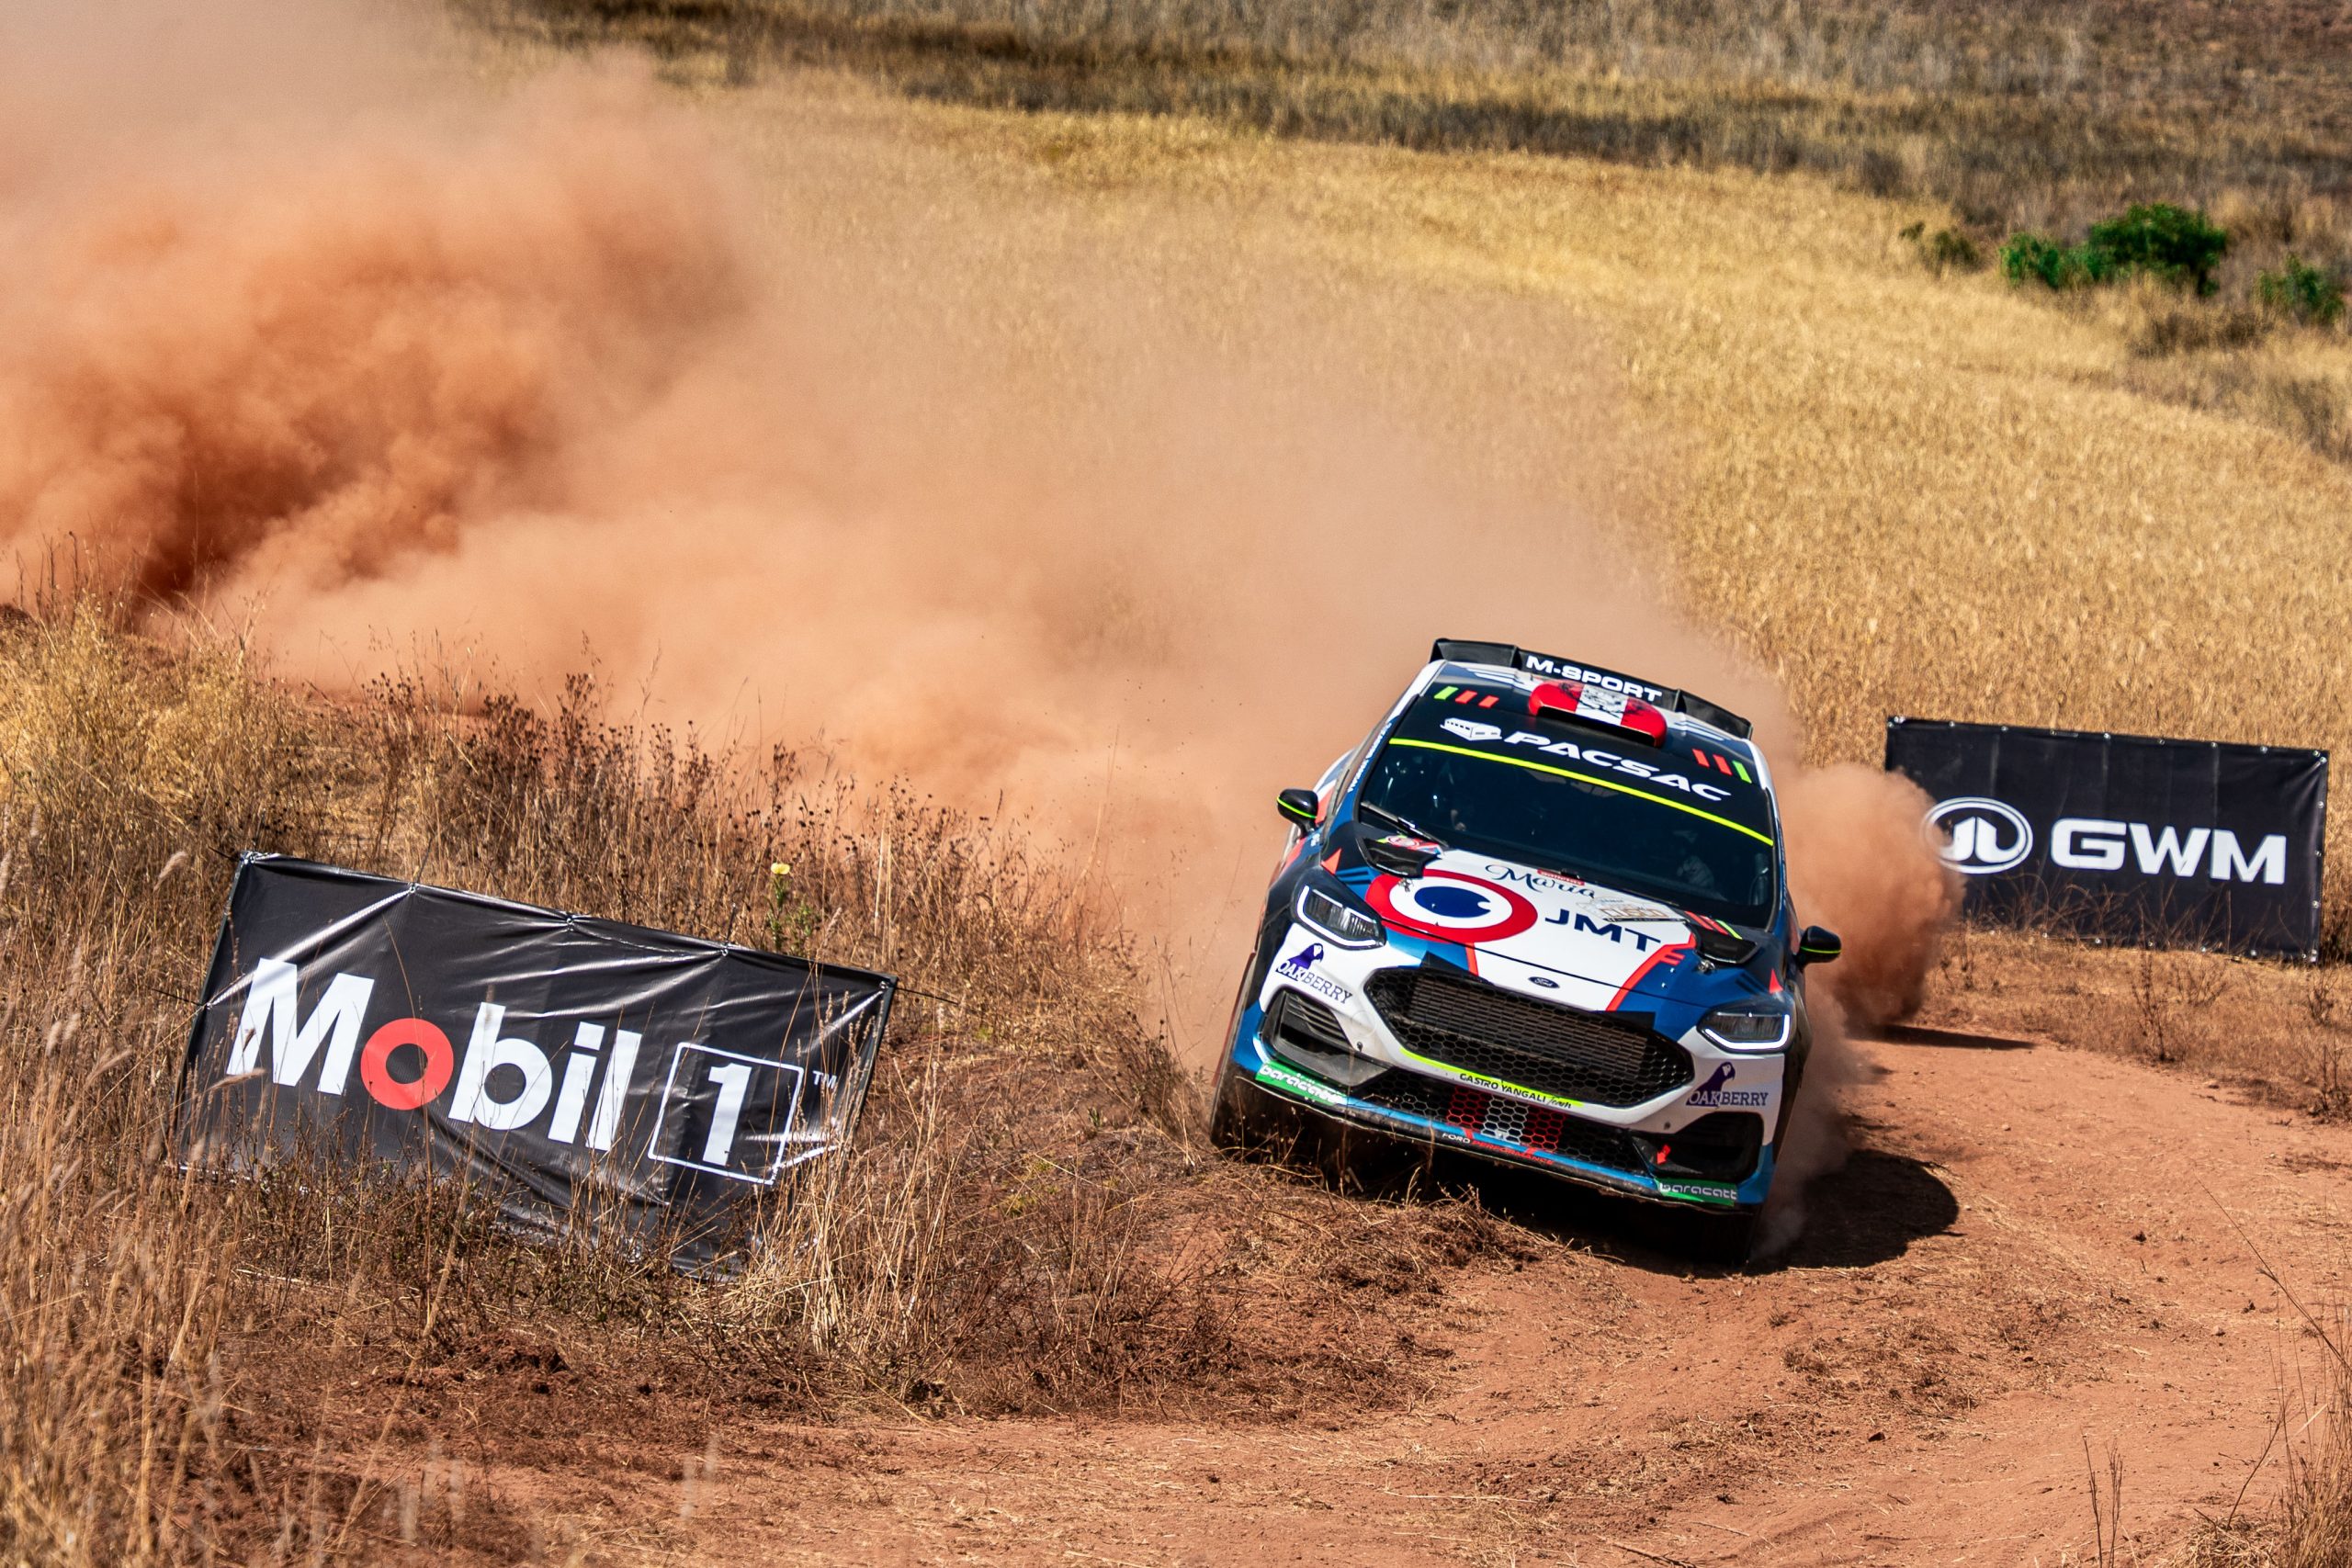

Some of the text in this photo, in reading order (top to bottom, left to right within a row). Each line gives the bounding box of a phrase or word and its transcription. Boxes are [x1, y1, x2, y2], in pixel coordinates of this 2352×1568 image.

[1526, 655, 1662, 702] M-SPORT
[1504, 731, 1732, 801] PACSAC
[2051, 818, 2288, 885] GWM
[1544, 908, 1661, 953] JMT
[1277, 959, 1353, 1004] OAKBERRY
[226, 958, 643, 1152] Mobil
[702, 1063, 752, 1167] 1
[1459, 1073, 1498, 1089] CASTRO
[1501, 1084, 1545, 1103] YANGALI
[1688, 1090, 1769, 1107] OAKBERRY
[1442, 1132, 1471, 1144] FORD
